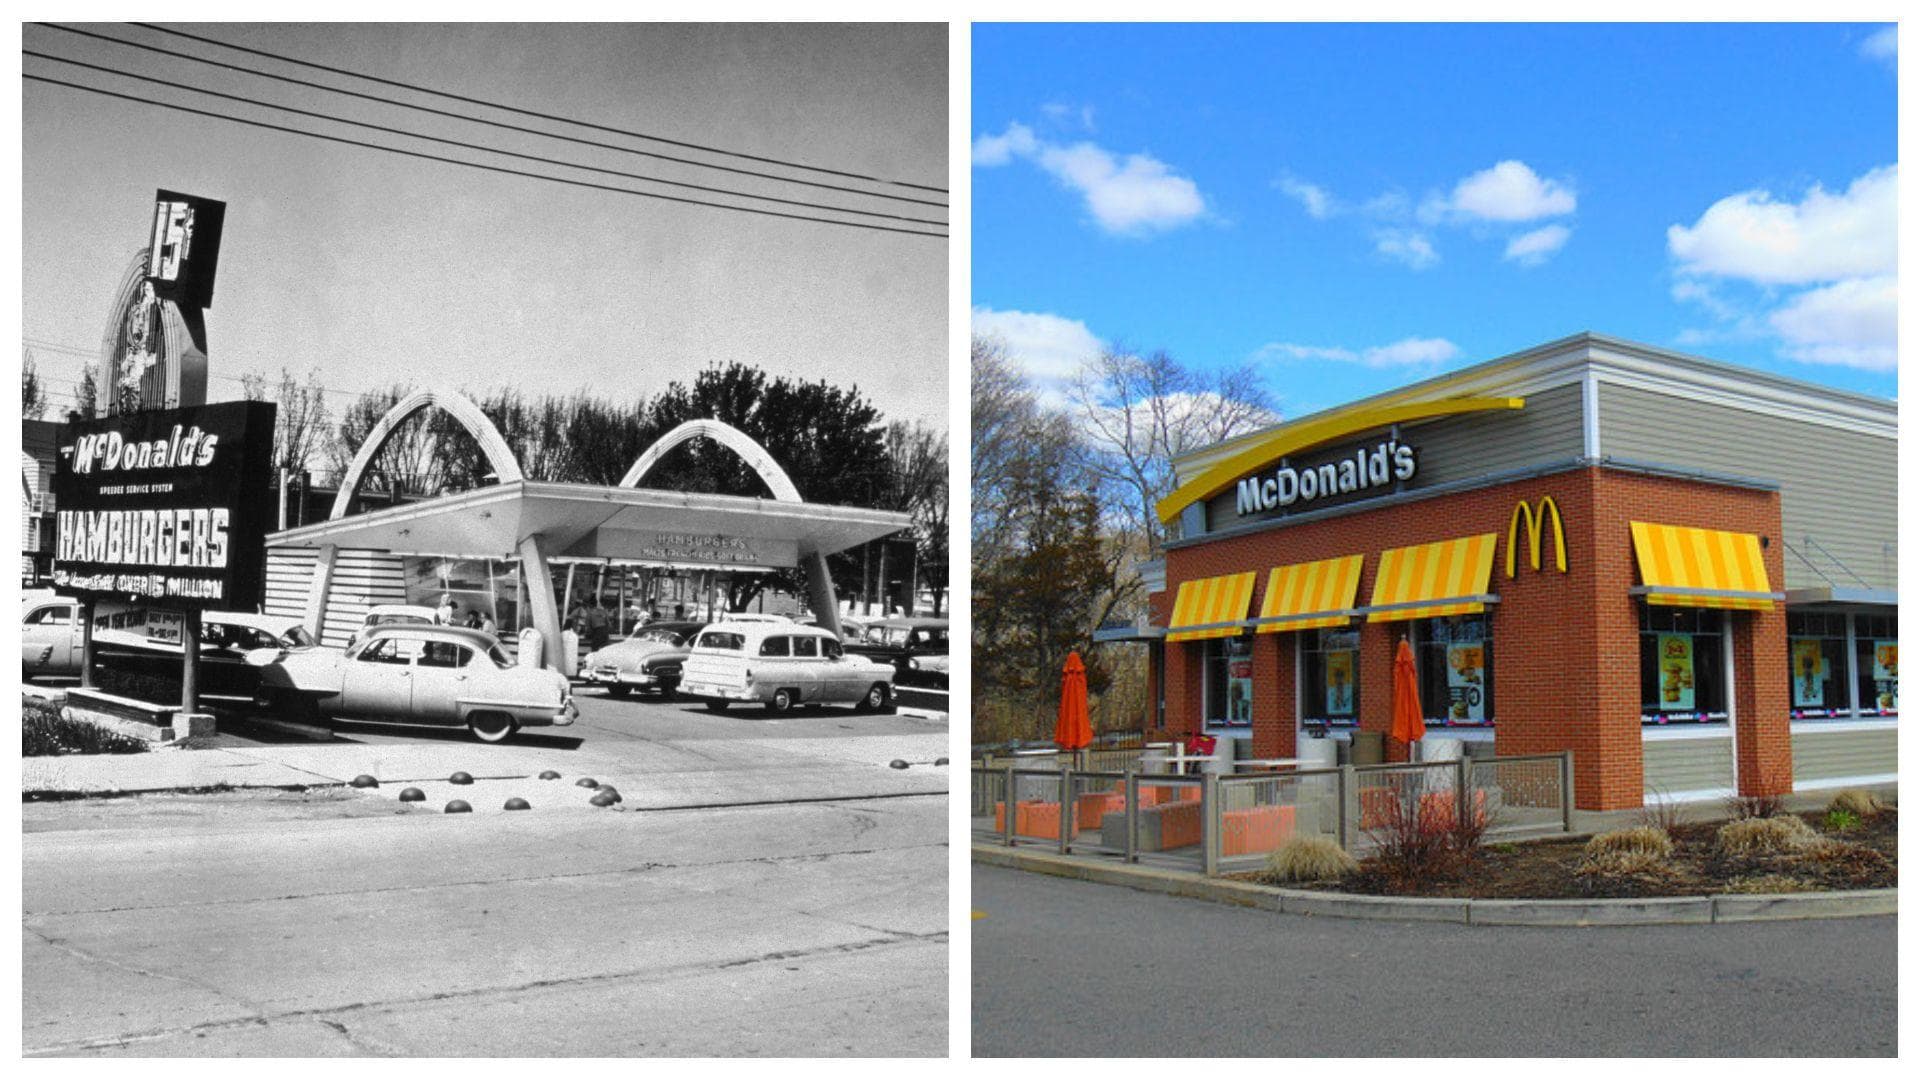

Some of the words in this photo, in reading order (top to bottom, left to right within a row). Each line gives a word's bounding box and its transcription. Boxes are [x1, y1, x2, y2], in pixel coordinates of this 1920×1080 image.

[73, 424, 219, 474] McDonald's
[126, 484, 149, 494] SERVICE
[151, 483, 174, 493] SYSTEM
[1237, 442, 1415, 516] McDonald's
[57, 508, 229, 567] HAMBURGERS
[658, 534, 745, 549] HAMBURGERS
[166, 577, 223, 599] MILLION
